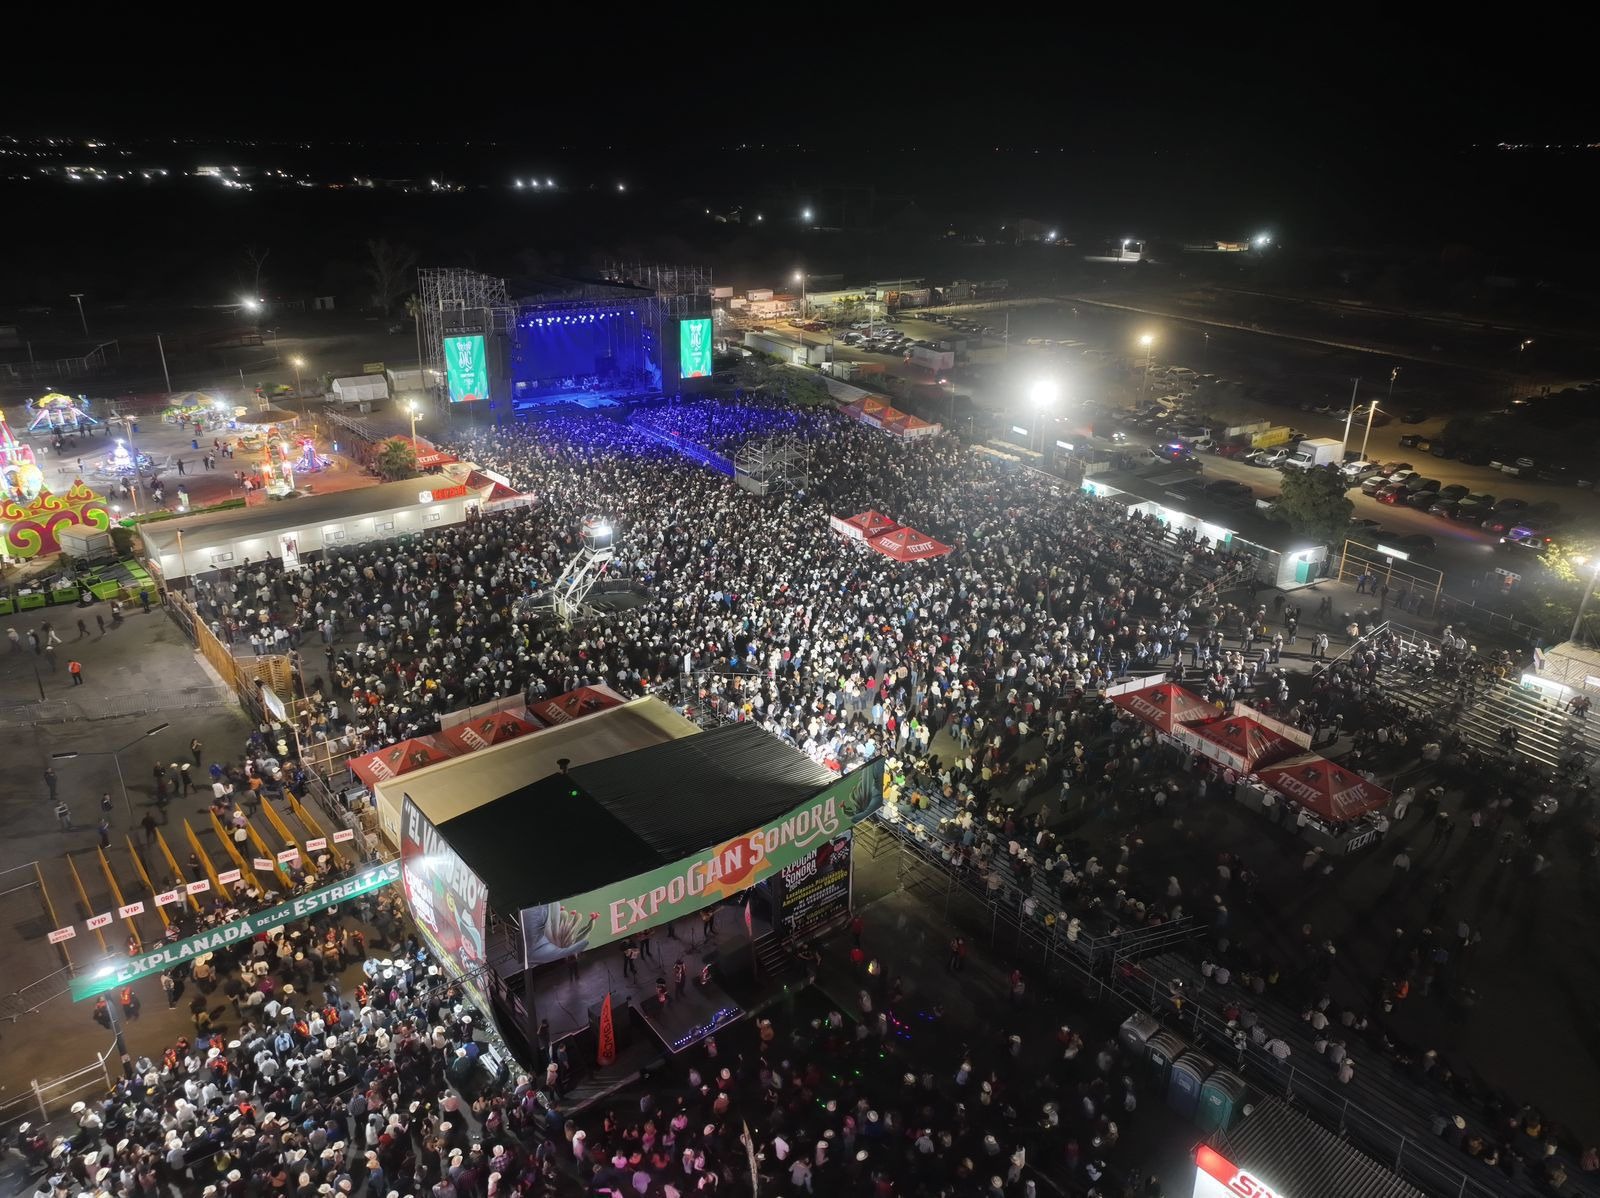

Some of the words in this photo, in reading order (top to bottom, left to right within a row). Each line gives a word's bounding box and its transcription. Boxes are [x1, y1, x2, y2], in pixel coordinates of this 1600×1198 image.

[906, 541, 935, 553] TECATE
[1130, 695, 1168, 721] TECATE
[1174, 706, 1206, 722] TECATE
[1276, 772, 1324, 802] TECATE
[1332, 784, 1368, 807] TECATE
[334, 832, 353, 840] GENERAL
[307, 841, 326, 849] GENERAL
[279, 851, 298, 860] GENERAL
[609, 844, 743, 936] EXPOGAN
[748, 796, 839, 866] SONORA
[192, 882, 206, 891] ORO
[160, 893, 175, 903] ORO
[124, 905, 140, 914] VIP
[91, 917, 107, 927] VIP
[117, 921, 254, 982] EXPLANADA
[256, 915, 270, 927] DE
[271, 908, 291, 921] LAS
[293, 861, 400, 917] ESTRELLAS
[1232, 1175, 1273, 1198] Si
